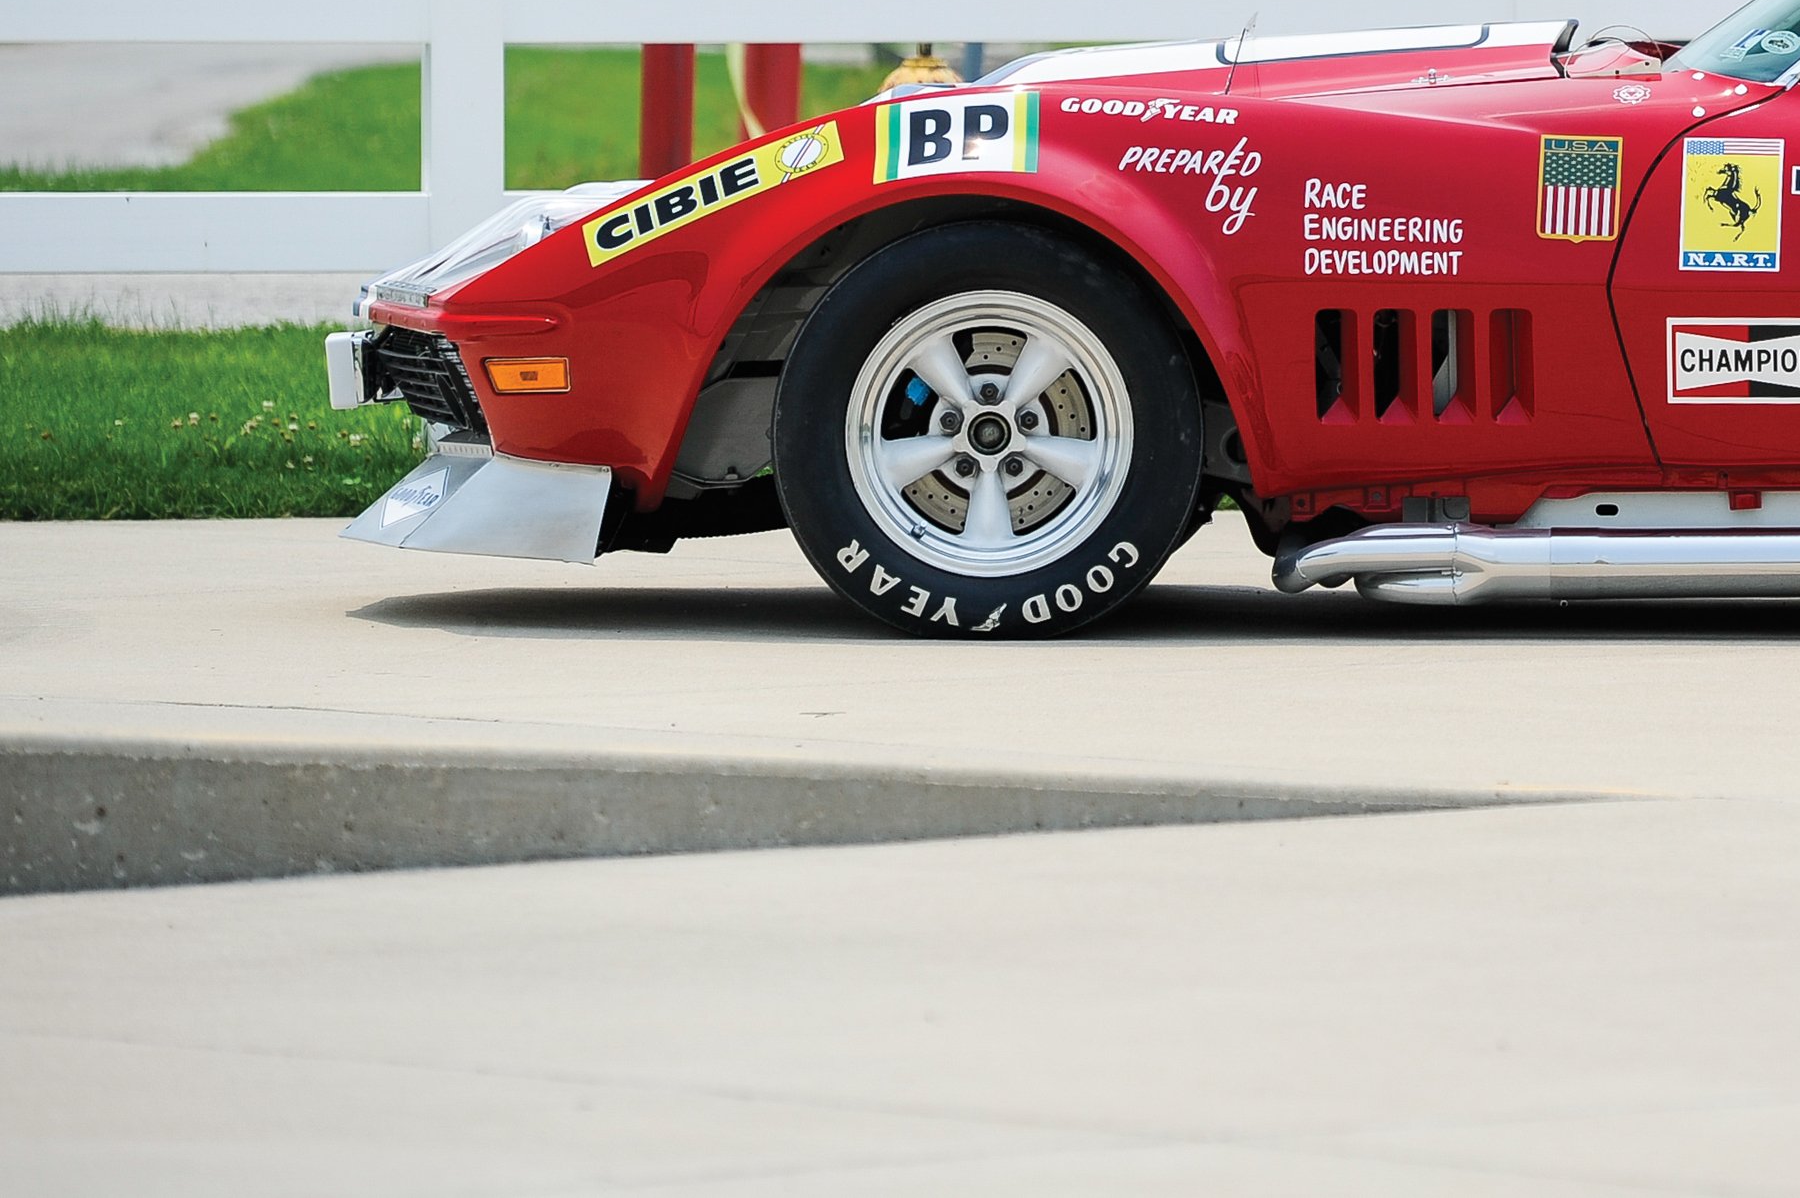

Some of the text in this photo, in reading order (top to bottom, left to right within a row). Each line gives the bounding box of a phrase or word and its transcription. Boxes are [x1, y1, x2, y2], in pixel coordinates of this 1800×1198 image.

[908, 105, 1008, 166] BP
[1551, 139, 1613, 152] U.S.A.
[1118, 145, 1262, 178] PREPARED
[1205, 137, 1258, 235] by
[1304, 178, 1367, 210] RACE
[595, 157, 760, 250] CIBIE
[1304, 213, 1463, 243] ENGINEERING
[1304, 248, 1462, 276] DEVELOPMENT
[1687, 253, 1772, 269] N.A.R.T.
